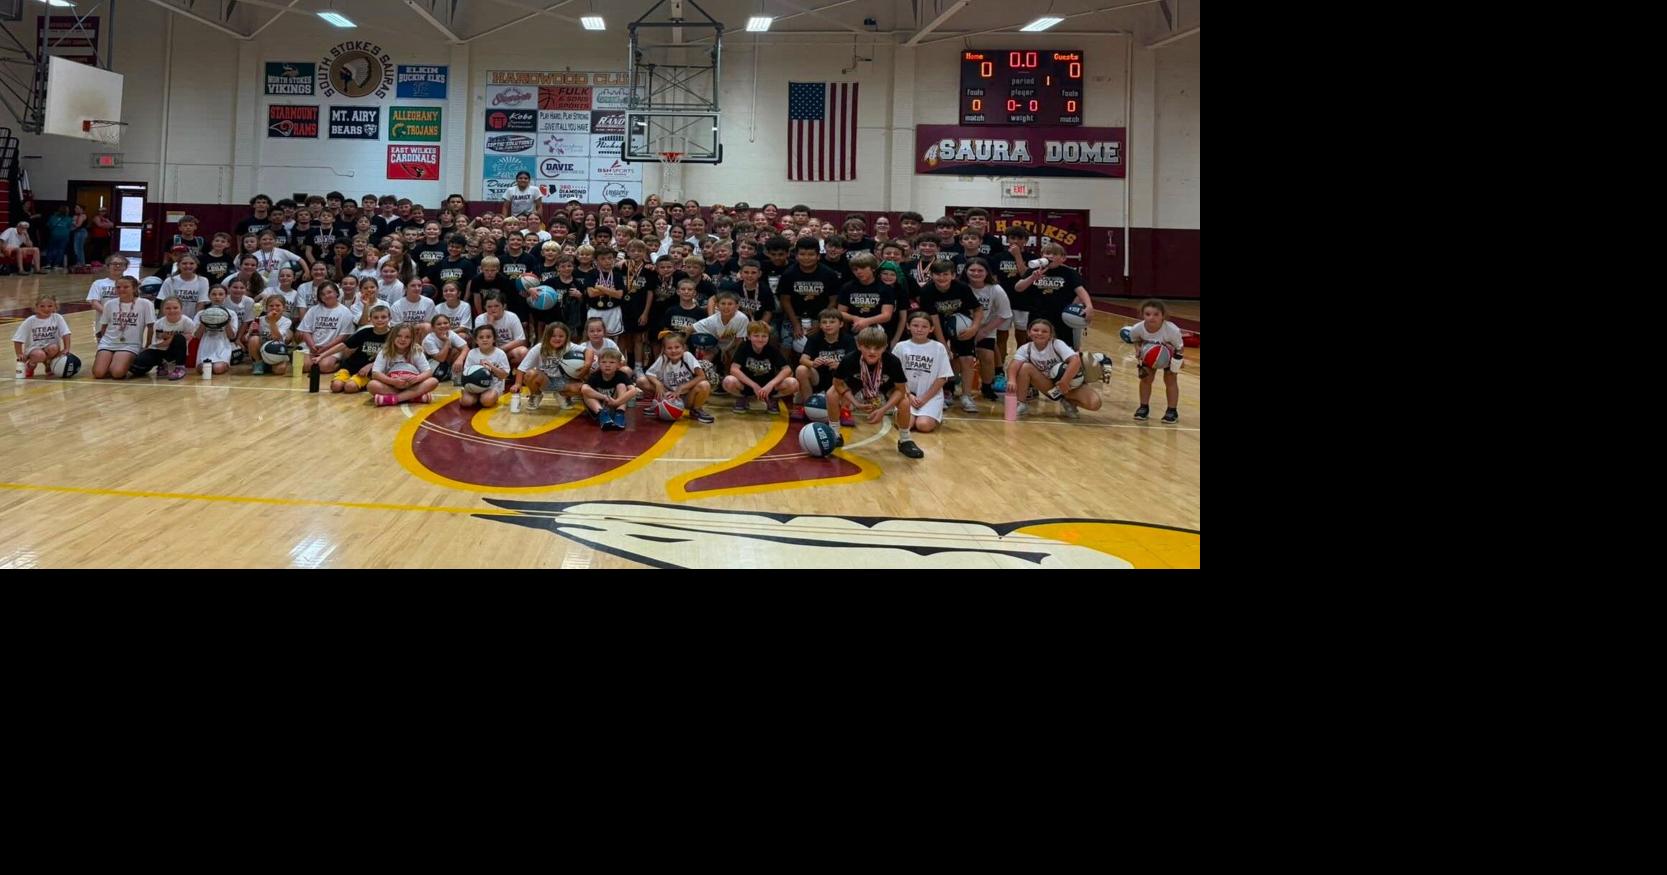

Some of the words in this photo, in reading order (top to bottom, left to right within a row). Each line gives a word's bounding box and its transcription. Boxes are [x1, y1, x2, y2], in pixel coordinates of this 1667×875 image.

[1009, 52, 1037, 68] 0.0
[1054, 53, 1079, 61] Guests
[318, 57, 335, 98] SOUTH
[330, 40, 382, 57] STOKES
[375, 54, 394, 100] SAURAS
[406, 66, 438, 74] ELKIN
[981, 62, 992, 77] 0
[1069, 62, 1080, 78] 0
[268, 75, 287, 83] NORTH
[288, 75, 312, 83] STOKES
[428, 75, 446, 83] ELKS
[493, 73, 589, 85] HARDWOOD
[1011, 77, 1035, 86] period
[268, 84, 312, 94] VIKINGS
[559, 87, 590, 95] FULK
[1010, 89, 1035, 97] player
[972, 99, 981, 111] 0
[1029, 100, 1038, 111] 0
[1067, 100, 1076, 112] 0
[270, 106, 318, 120] STARMOUNT
[331, 110, 350, 122] MT.
[351, 110, 377, 122] AIRY
[393, 110, 438, 121] ALLEGHANY
[510, 112, 533, 120] Kobe
[573, 112, 589, 120] STRONG
[965, 114, 985, 122] match
[1011, 114, 1034, 123] weight
[293, 123, 317, 136] RAMS
[331, 125, 363, 135] BEARS
[405, 125, 438, 136] TROJANS
[410, 147, 437, 155] WILKES
[938, 138, 1032, 163] SAURA
[1045, 140, 1121, 165] DOME
[391, 154, 436, 164] CARDINALS
[546, 163, 574, 171] DAVIE
[1013, 185, 1026, 194] EXIT
[910, 354, 934, 363] TEAM
[910, 361, 932, 370] FAMILY
